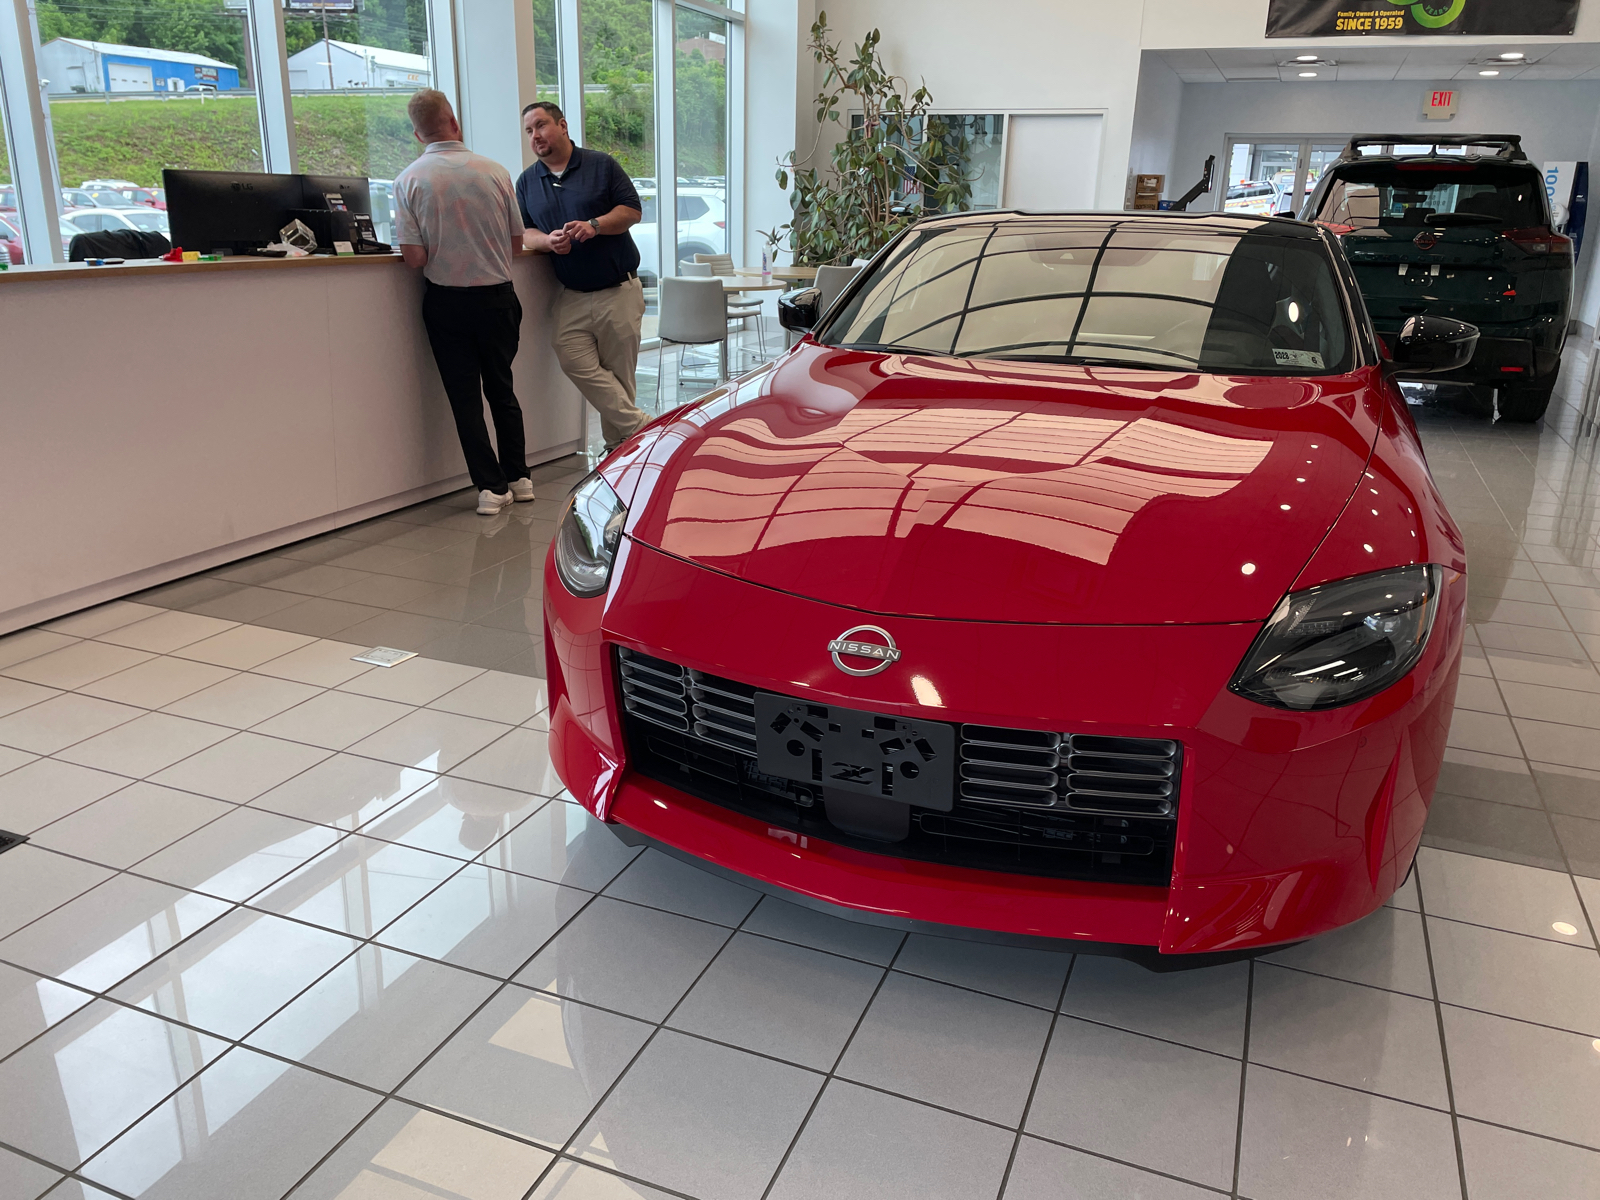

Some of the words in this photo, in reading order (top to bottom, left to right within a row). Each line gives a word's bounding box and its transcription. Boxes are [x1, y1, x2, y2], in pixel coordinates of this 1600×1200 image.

[1425, 5, 1448, 15] YEARS
[1336, 18, 1372, 30] SINCE
[1375, 17, 1403, 30] 1959
[1431, 91, 1453, 107] EXIT
[829, 642, 899, 660] NISSAN
